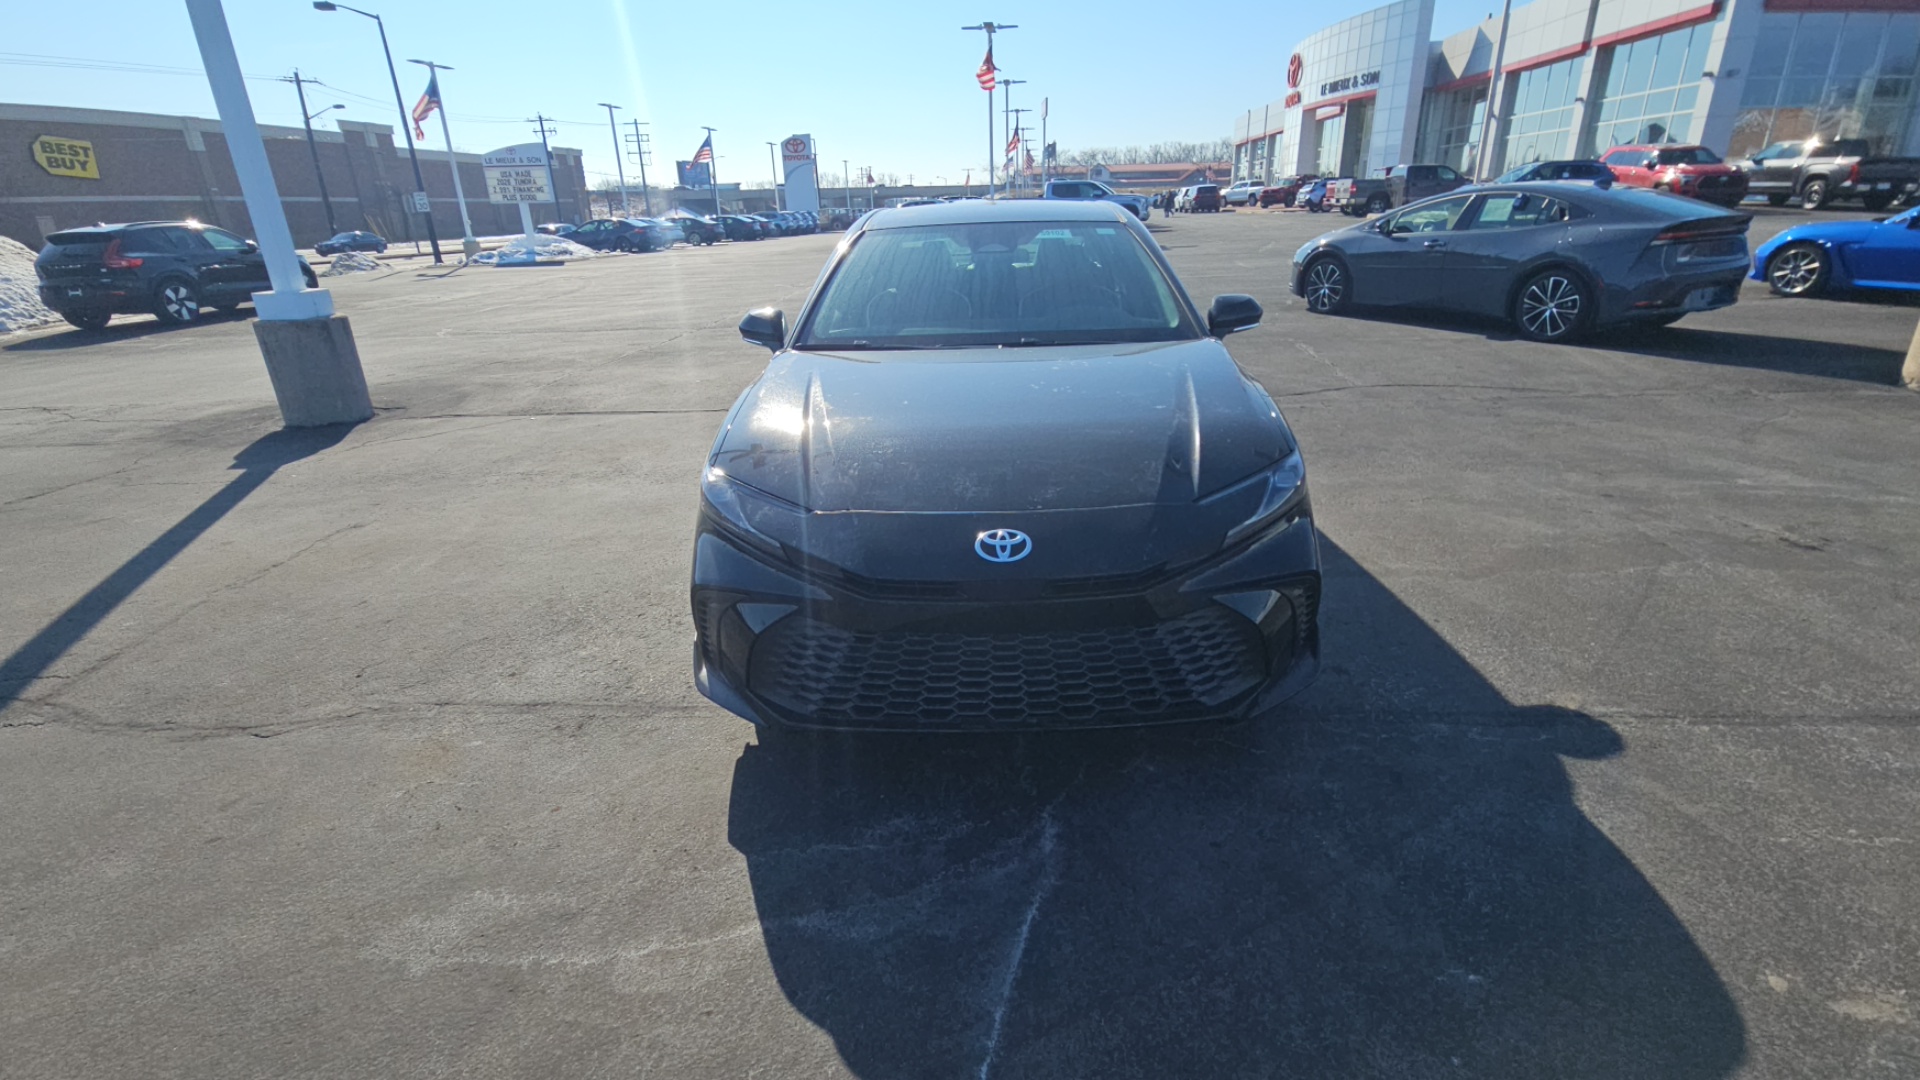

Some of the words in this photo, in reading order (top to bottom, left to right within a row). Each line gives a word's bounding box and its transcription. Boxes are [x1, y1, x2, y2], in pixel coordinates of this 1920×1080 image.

[1321, 82, 1328, 96] LE
[1328, 78, 1351, 94] MIEUX
[1351, 75, 1359, 88] &
[1360, 70, 1380, 86] SON
[39, 140, 91, 158] BEST
[45, 156, 89, 172] BUY
[500, 170, 512, 178] USA
[514, 178, 537, 186] TUNDRA
